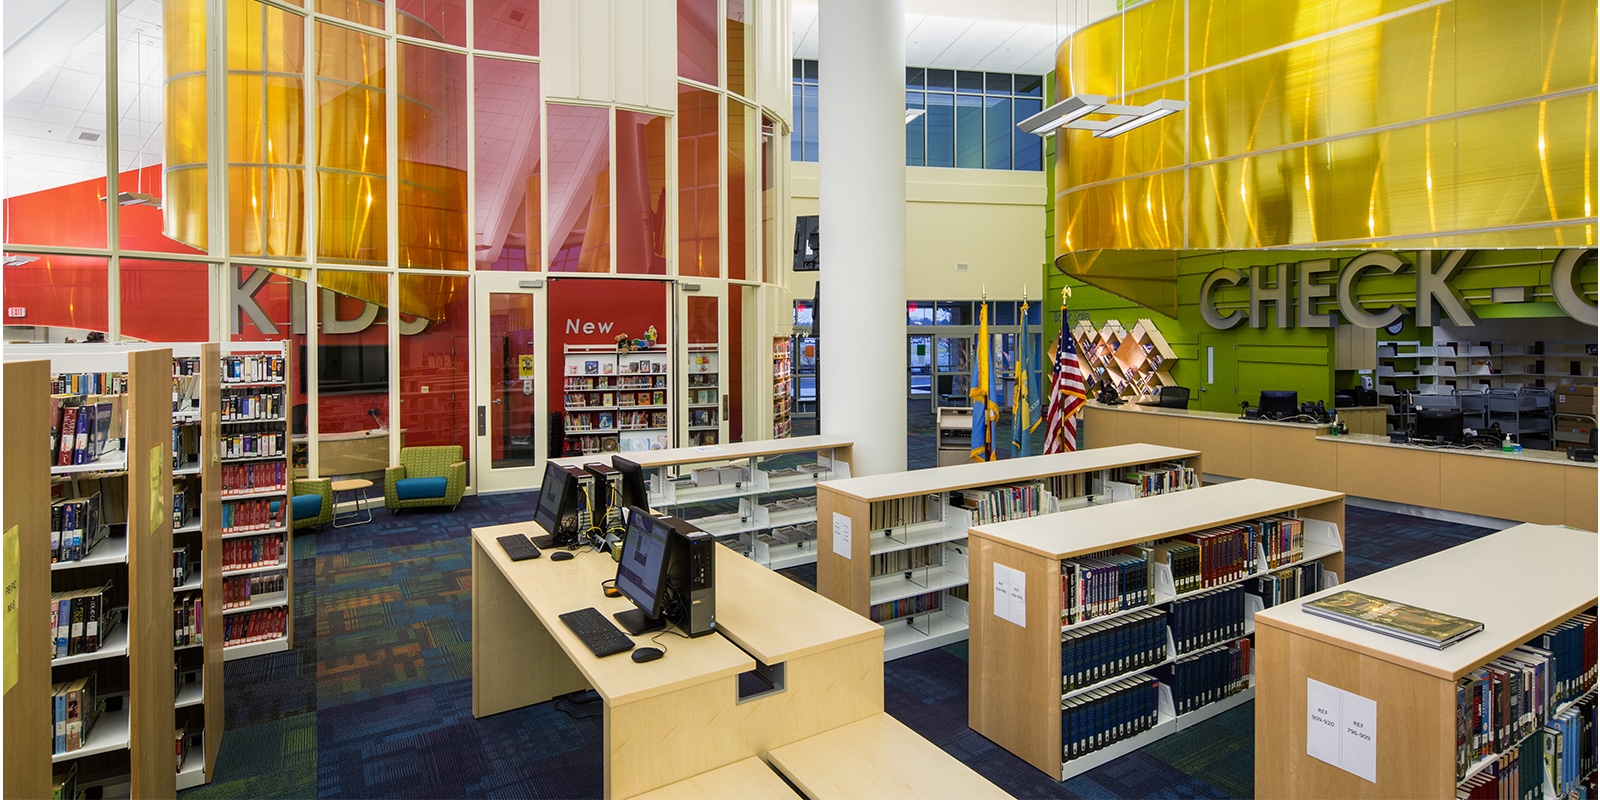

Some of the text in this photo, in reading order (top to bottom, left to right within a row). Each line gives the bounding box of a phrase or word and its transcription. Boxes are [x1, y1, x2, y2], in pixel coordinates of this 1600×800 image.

[1053, 311, 1072, 322] Bk
[565, 318, 614, 334] New
[1317, 707, 1328, 715] REF
[1311, 714, 1335, 728] 909-920
[1353, 720, 1364, 729] REF
[1347, 727, 1371, 741] 796-909
